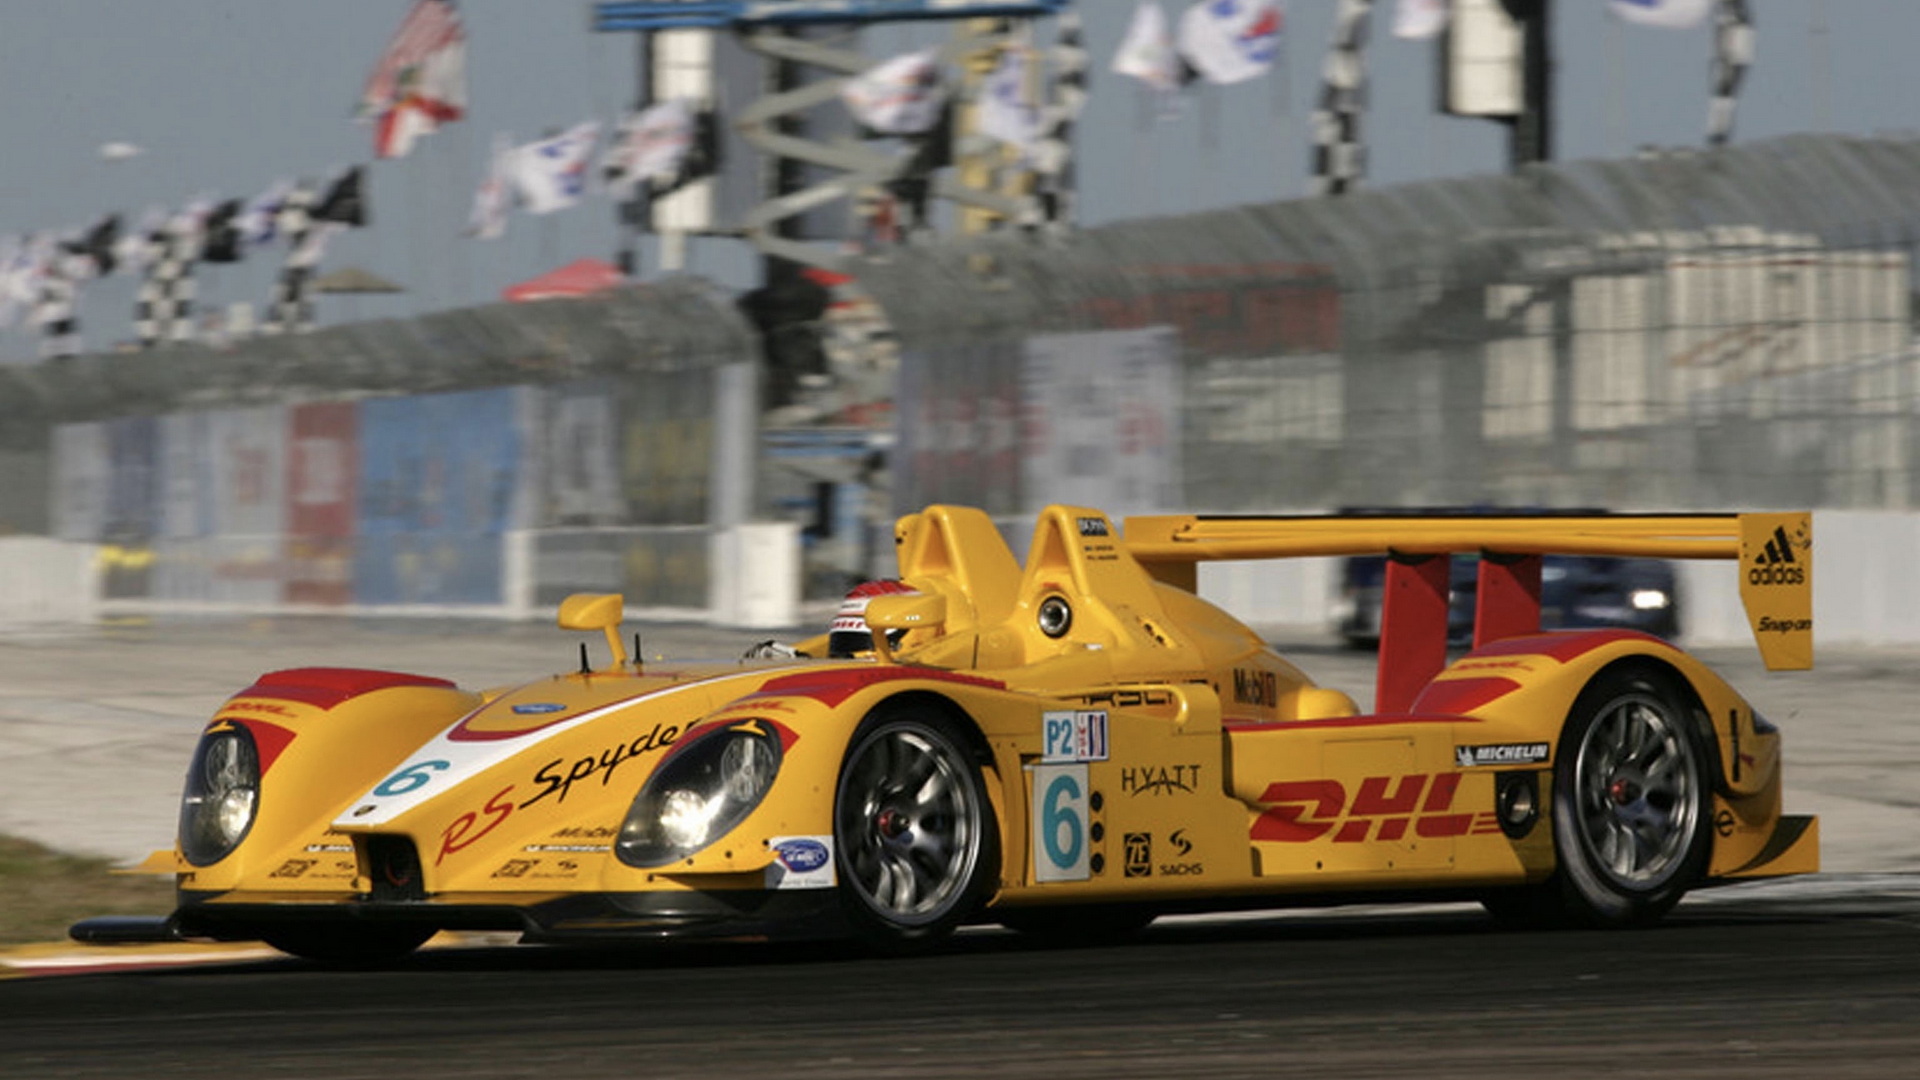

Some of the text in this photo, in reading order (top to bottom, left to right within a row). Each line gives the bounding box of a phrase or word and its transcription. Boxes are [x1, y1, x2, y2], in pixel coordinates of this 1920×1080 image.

[1749, 562, 1805, 586] adidas
[1047, 718, 1073, 755] P2
[1476, 744, 1548, 760] MICHELIN
[373, 760, 451, 797] 6
[436, 718, 703, 867] RS Spyder
[1121, 765, 1201, 797] HYATT
[1042, 775, 1083, 870] 6
[1250, 772, 1478, 843] DHL
